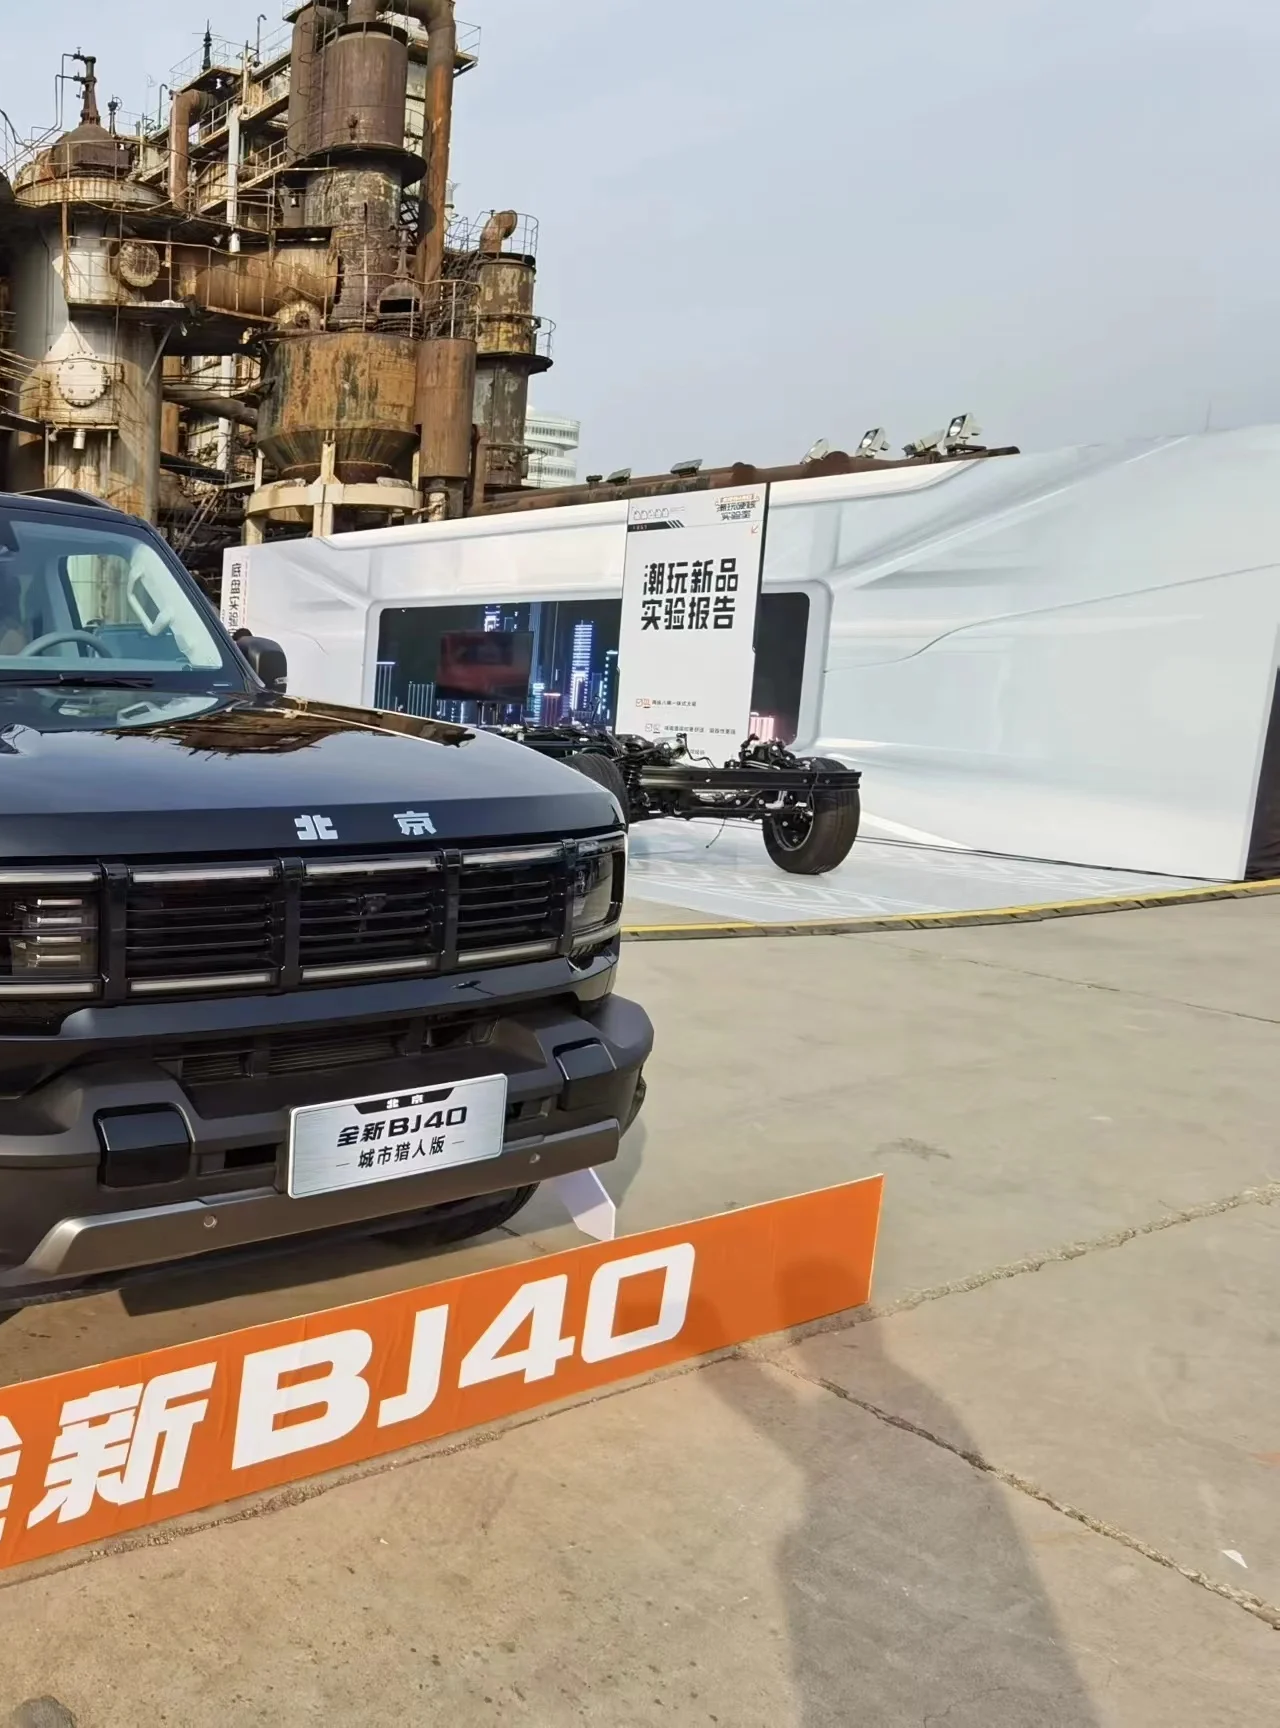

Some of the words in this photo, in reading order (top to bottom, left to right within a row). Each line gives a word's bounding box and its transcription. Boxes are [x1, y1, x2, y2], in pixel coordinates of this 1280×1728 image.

[643, 558, 739, 595] 潮玩新品
[641, 596, 736, 630] 实验报告
[294, 810, 437, 840] 北京
[386, 1093, 424, 1110] 北京
[337, 1106, 468, 1148] 全新BJ40
[357, 1135, 447, 1169] 城市猎人版
